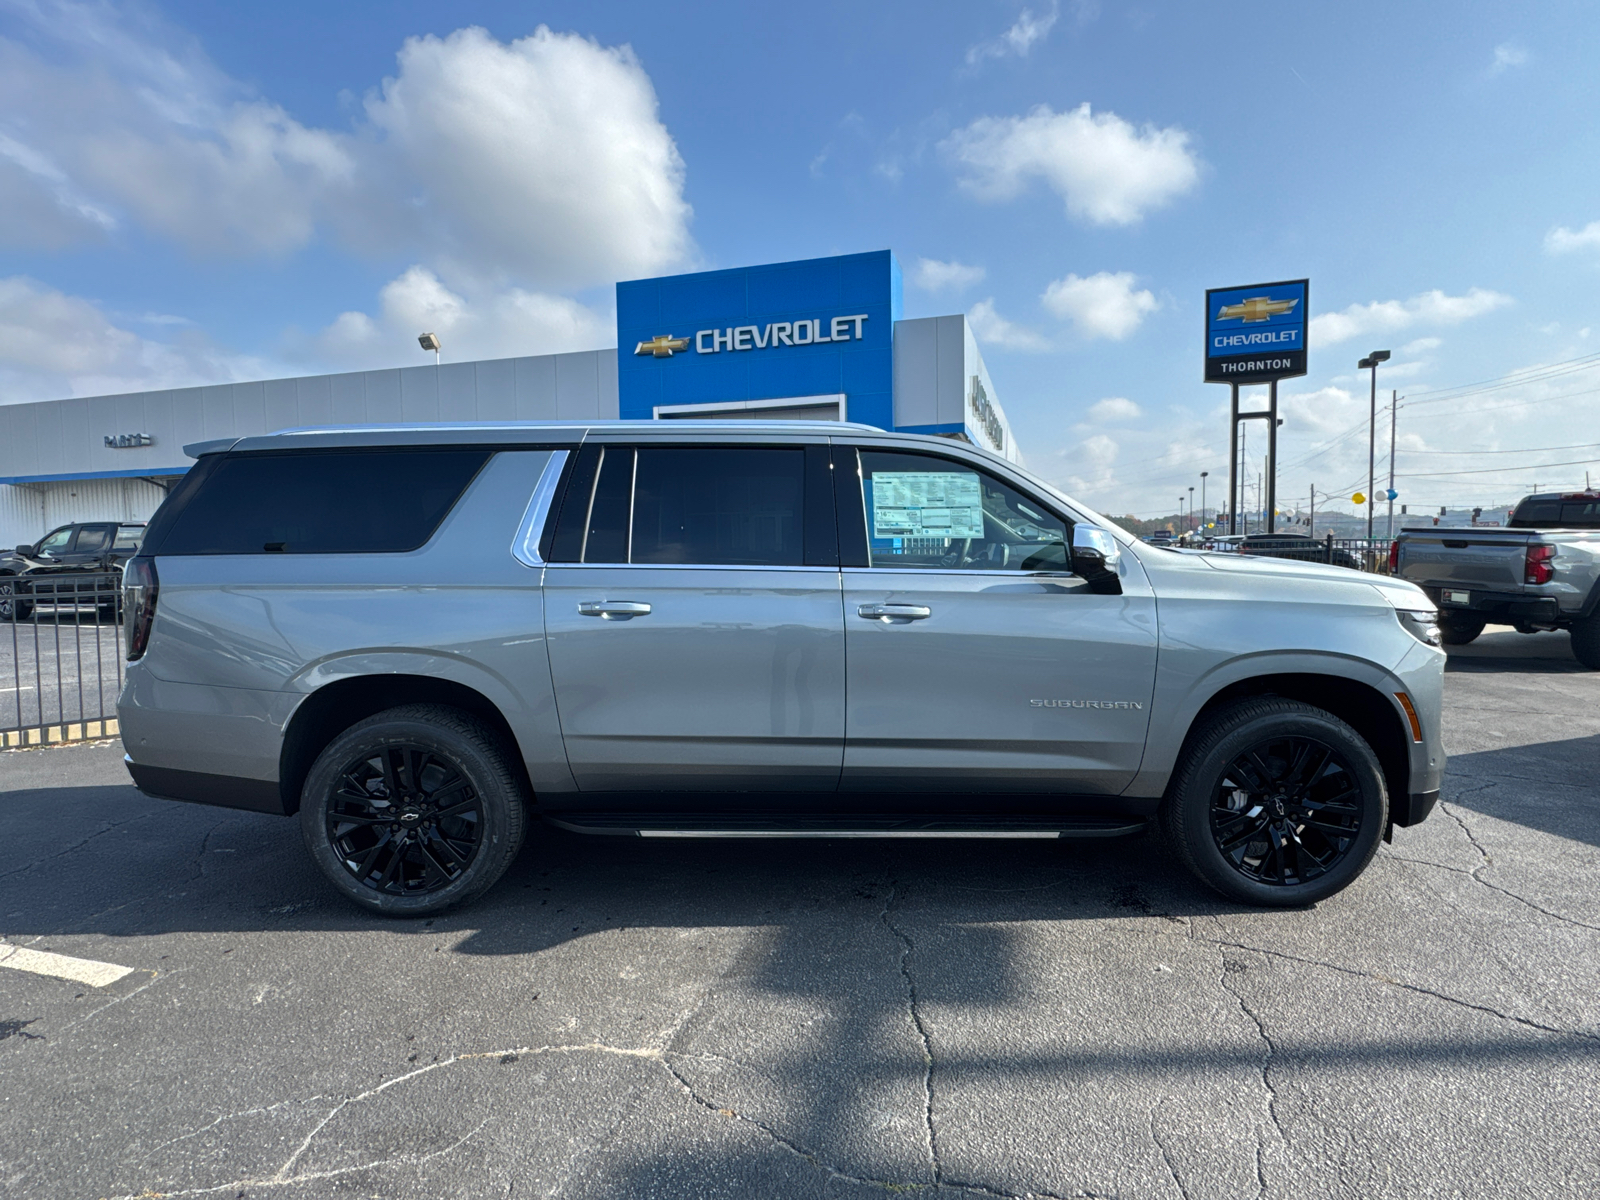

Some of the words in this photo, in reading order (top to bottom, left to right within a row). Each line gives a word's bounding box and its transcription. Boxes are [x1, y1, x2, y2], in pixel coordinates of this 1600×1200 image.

[695, 313, 868, 354] CHEVROLET
[1214, 330, 1299, 347] CHEVROLET
[1220, 358, 1291, 373] THORNTON
[104, 433, 150, 448] PARTS
[1030, 699, 1143, 710] SUBURBAN
